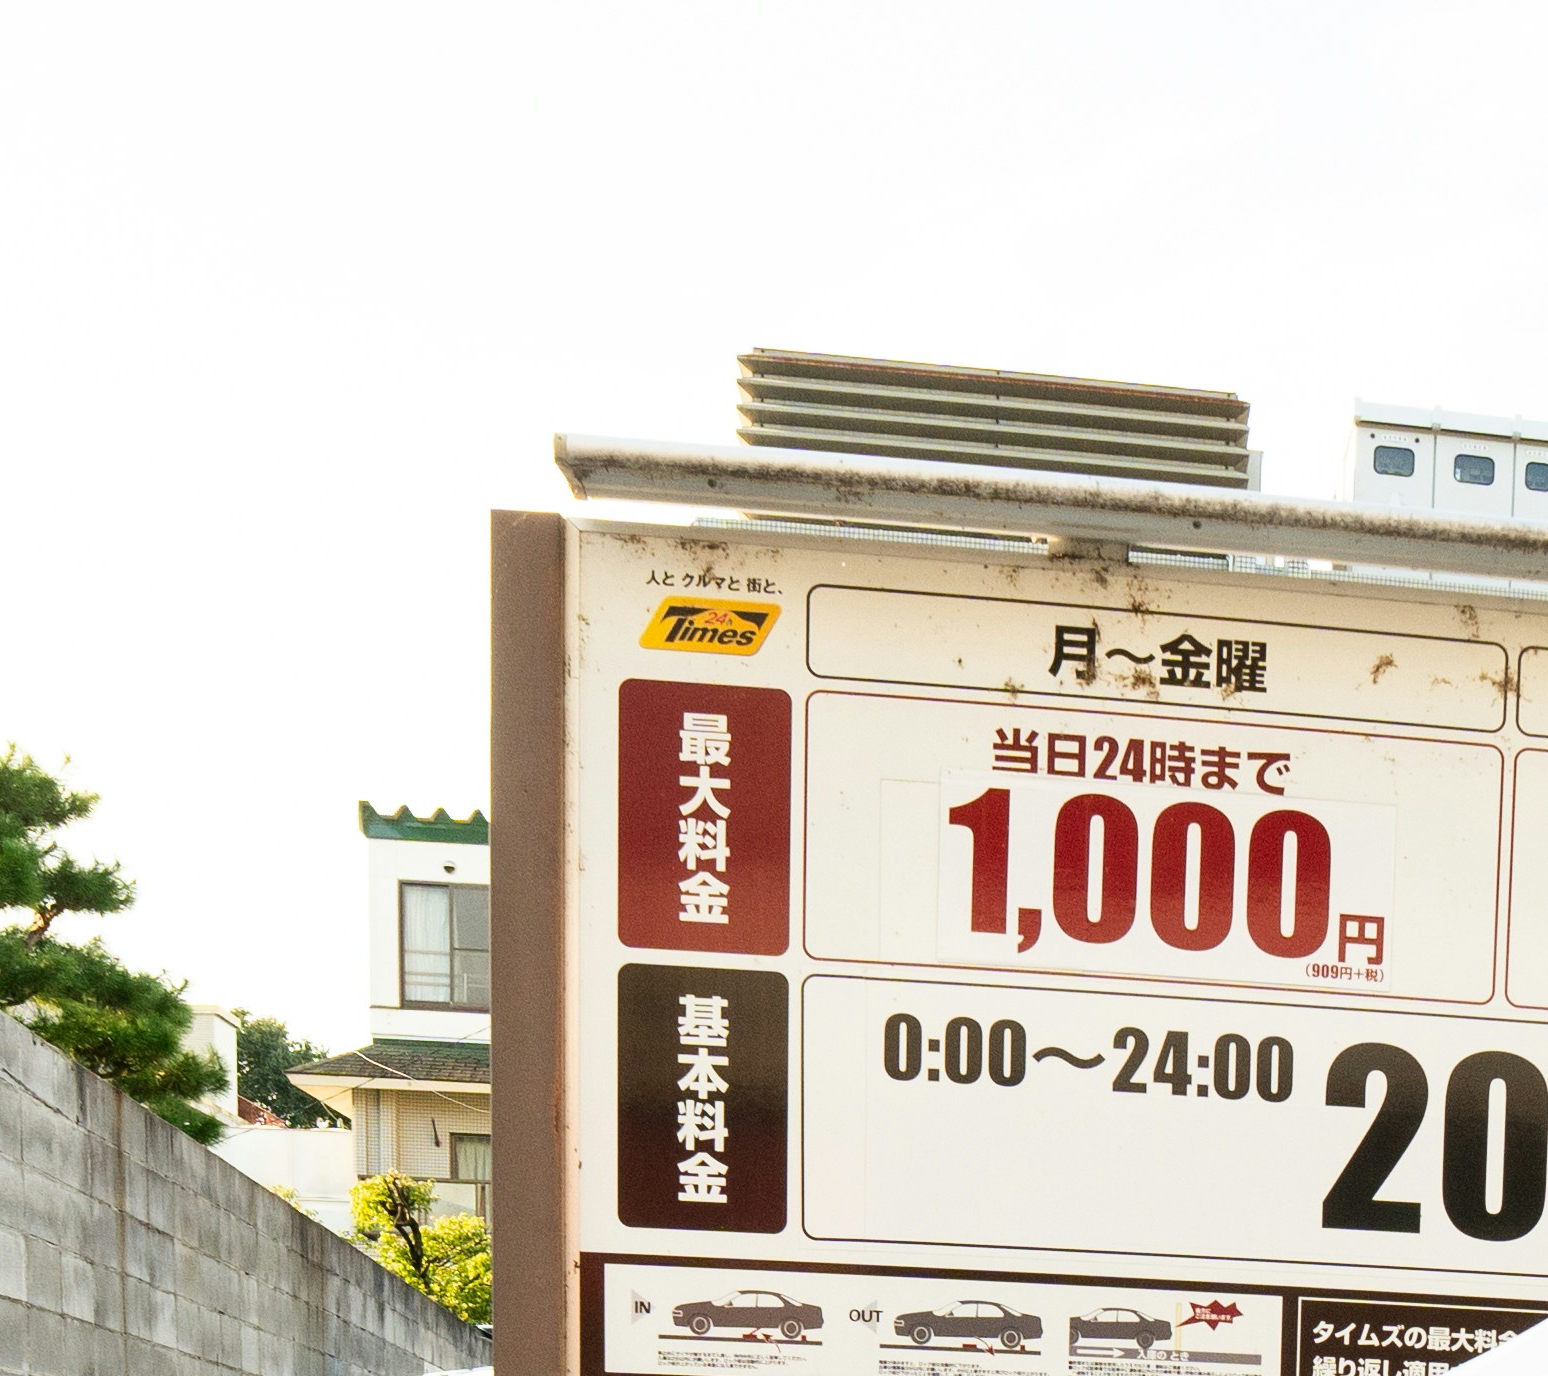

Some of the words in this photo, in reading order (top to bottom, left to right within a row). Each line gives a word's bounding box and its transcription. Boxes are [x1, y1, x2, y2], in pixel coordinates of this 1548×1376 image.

[664, 616, 756, 646] Times
[992, 729, 1292, 795] 当日24時まで
[678, 713, 730, 924] 最大料金
[677, 995, 729, 1205] 基本料金
[634, 1301, 651, 1314] IN
[848, 1309, 883, 1323] OUT
